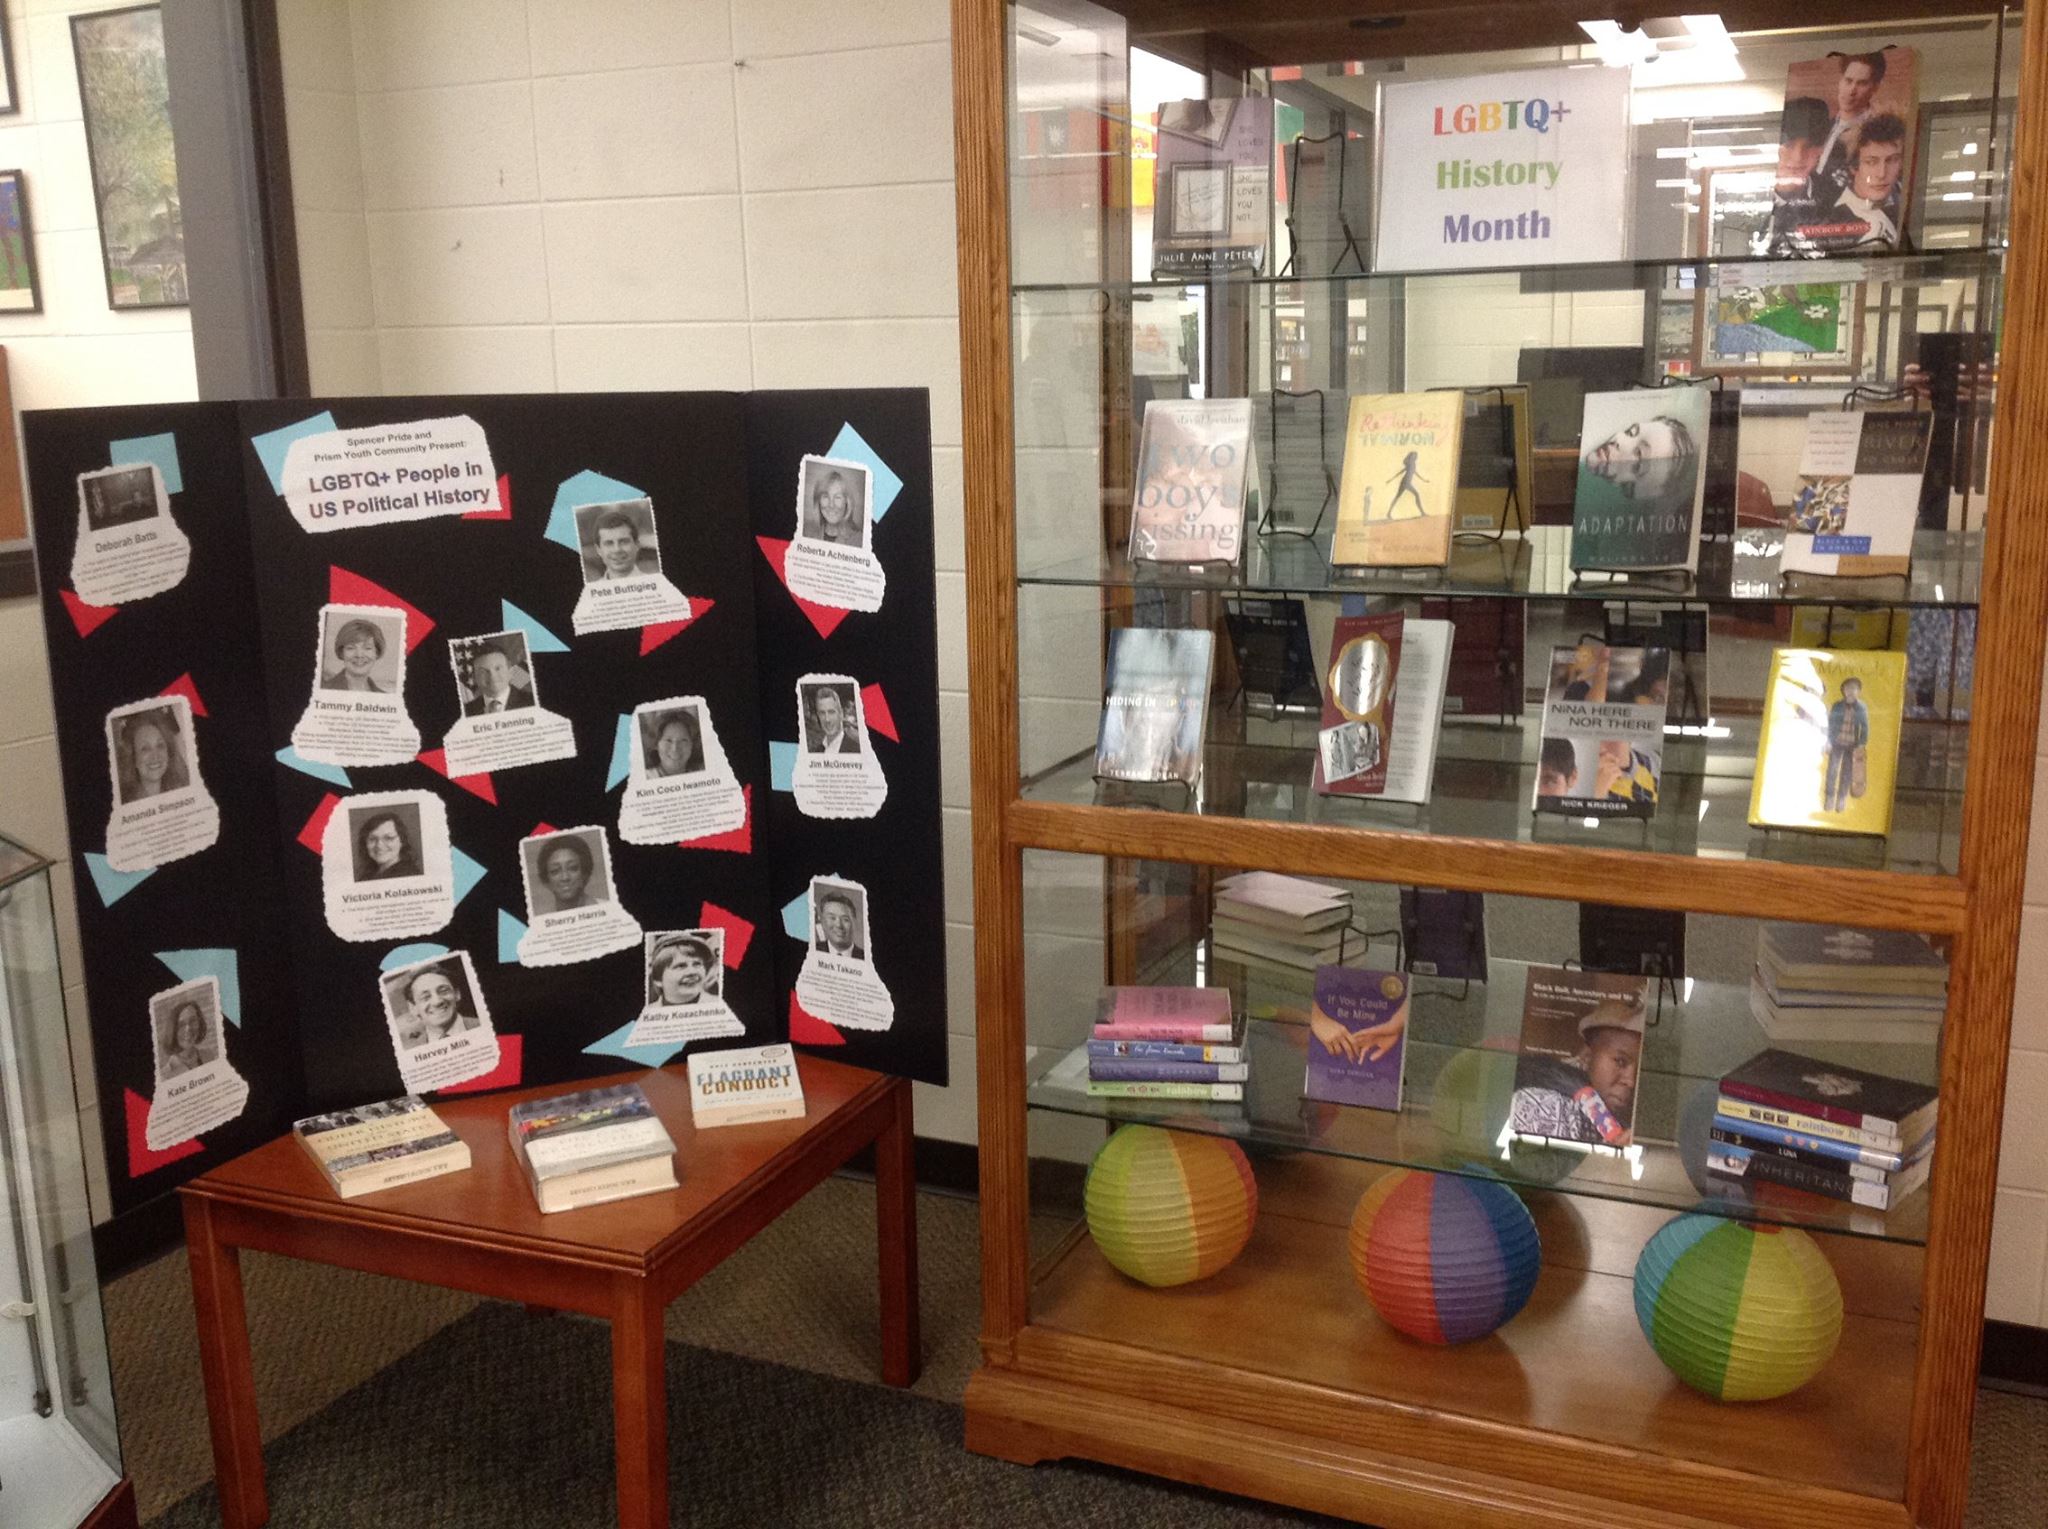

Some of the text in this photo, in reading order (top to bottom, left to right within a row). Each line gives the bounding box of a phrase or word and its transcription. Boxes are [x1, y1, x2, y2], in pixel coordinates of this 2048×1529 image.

[1434, 98, 1571, 136] LGBTQ+
[1436, 158, 1563, 190] History
[1236, 186, 1263, 197] LOVES
[1237, 200, 1252, 209] YOU
[1443, 209, 1551, 243] Month
[1798, 224, 1843, 235] AINBOW
[1158, 249, 1260, 264] JULIE ANNE PETERS
[347, 431, 432, 447] Spencer Pride and
[314, 440, 467, 463] Prism Youth Community Present:
[309, 461, 483, 494] LGBTQ+ People in
[309, 488, 490, 519] US Political History
[1579, 513, 1688, 535] ADAPTATION
[95, 536, 133, 553] Deborah
[797, 543, 871, 567] Roberta Achtenberg
[590, 582, 657, 598] Pete Buttigieg
[314, 700, 397, 714] Tammy Baldwin
[1592, 706, 1632, 717] HERE
[473, 717, 535, 734] Eric Fanning
[1569, 717, 1656, 731] NOR THERE
[809, 760, 863, 770] Jim McGreevey
[636, 778, 721, 798] Kim Coco Iwamoto
[121, 797, 196, 825] Amanda Simpson
[1561, 799, 1629, 811] NICK KRIEGER
[342, 884, 443, 903] Victoria Kolakowski
[545, 915, 577, 928] Sherry
[817, 959, 863, 977] Mark Takano
[1327, 994, 1388, 1009] If You Could
[643, 1007, 726, 1022] Kathy Kozachenko
[1337, 1007, 1377, 1021] Be Mine
[414, 1038, 471, 1062] Harvey Milk
[697, 1064, 793, 1087] FLAGRANT
[167, 1073, 216, 1098] Kate Brown
[702, 1076, 790, 1096] CONDUCT
[1796, 1118, 1844, 1136] rainbow
[1778, 1147, 1798, 1159] LUNA
[1754, 1161, 1853, 1197] INHERITANC
